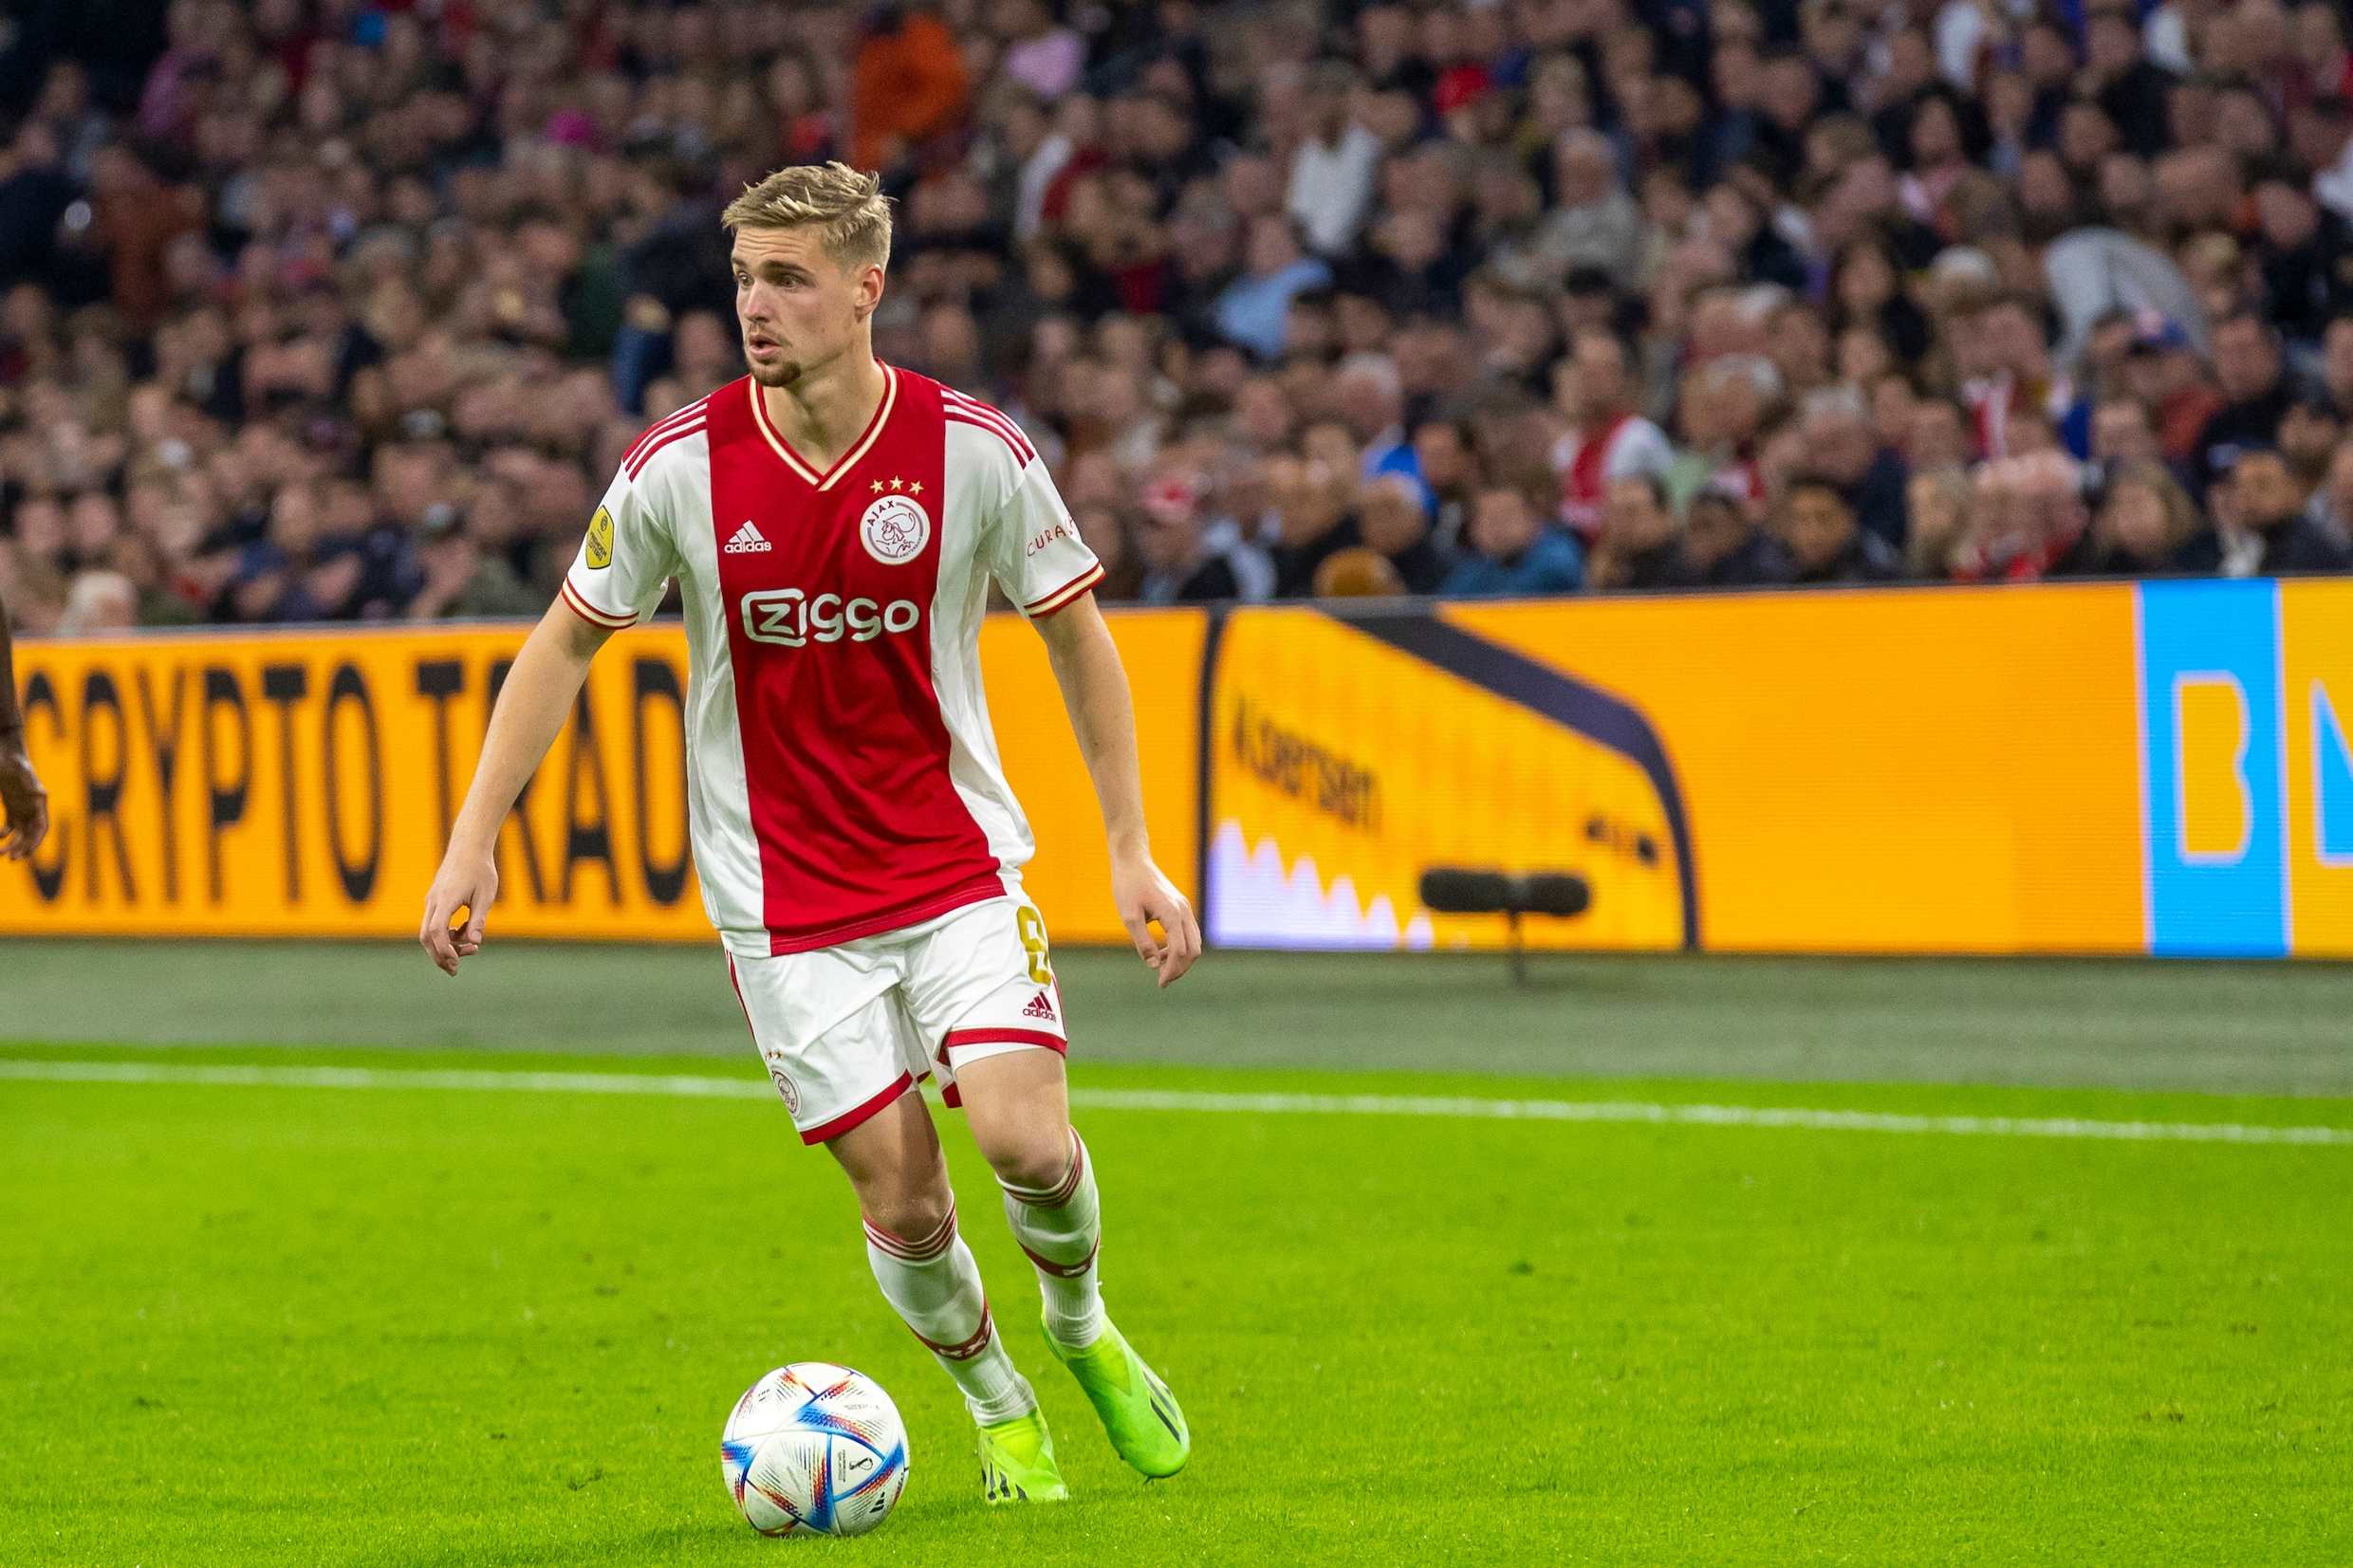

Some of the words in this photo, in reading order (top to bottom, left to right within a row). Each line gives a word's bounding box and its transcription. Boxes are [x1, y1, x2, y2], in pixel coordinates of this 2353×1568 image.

[867, 500, 895, 526] AJAX
[724, 540, 772, 554] adidas
[21, 664, 382, 903] CRYPTO
[1016, 905, 1052, 987] 8
